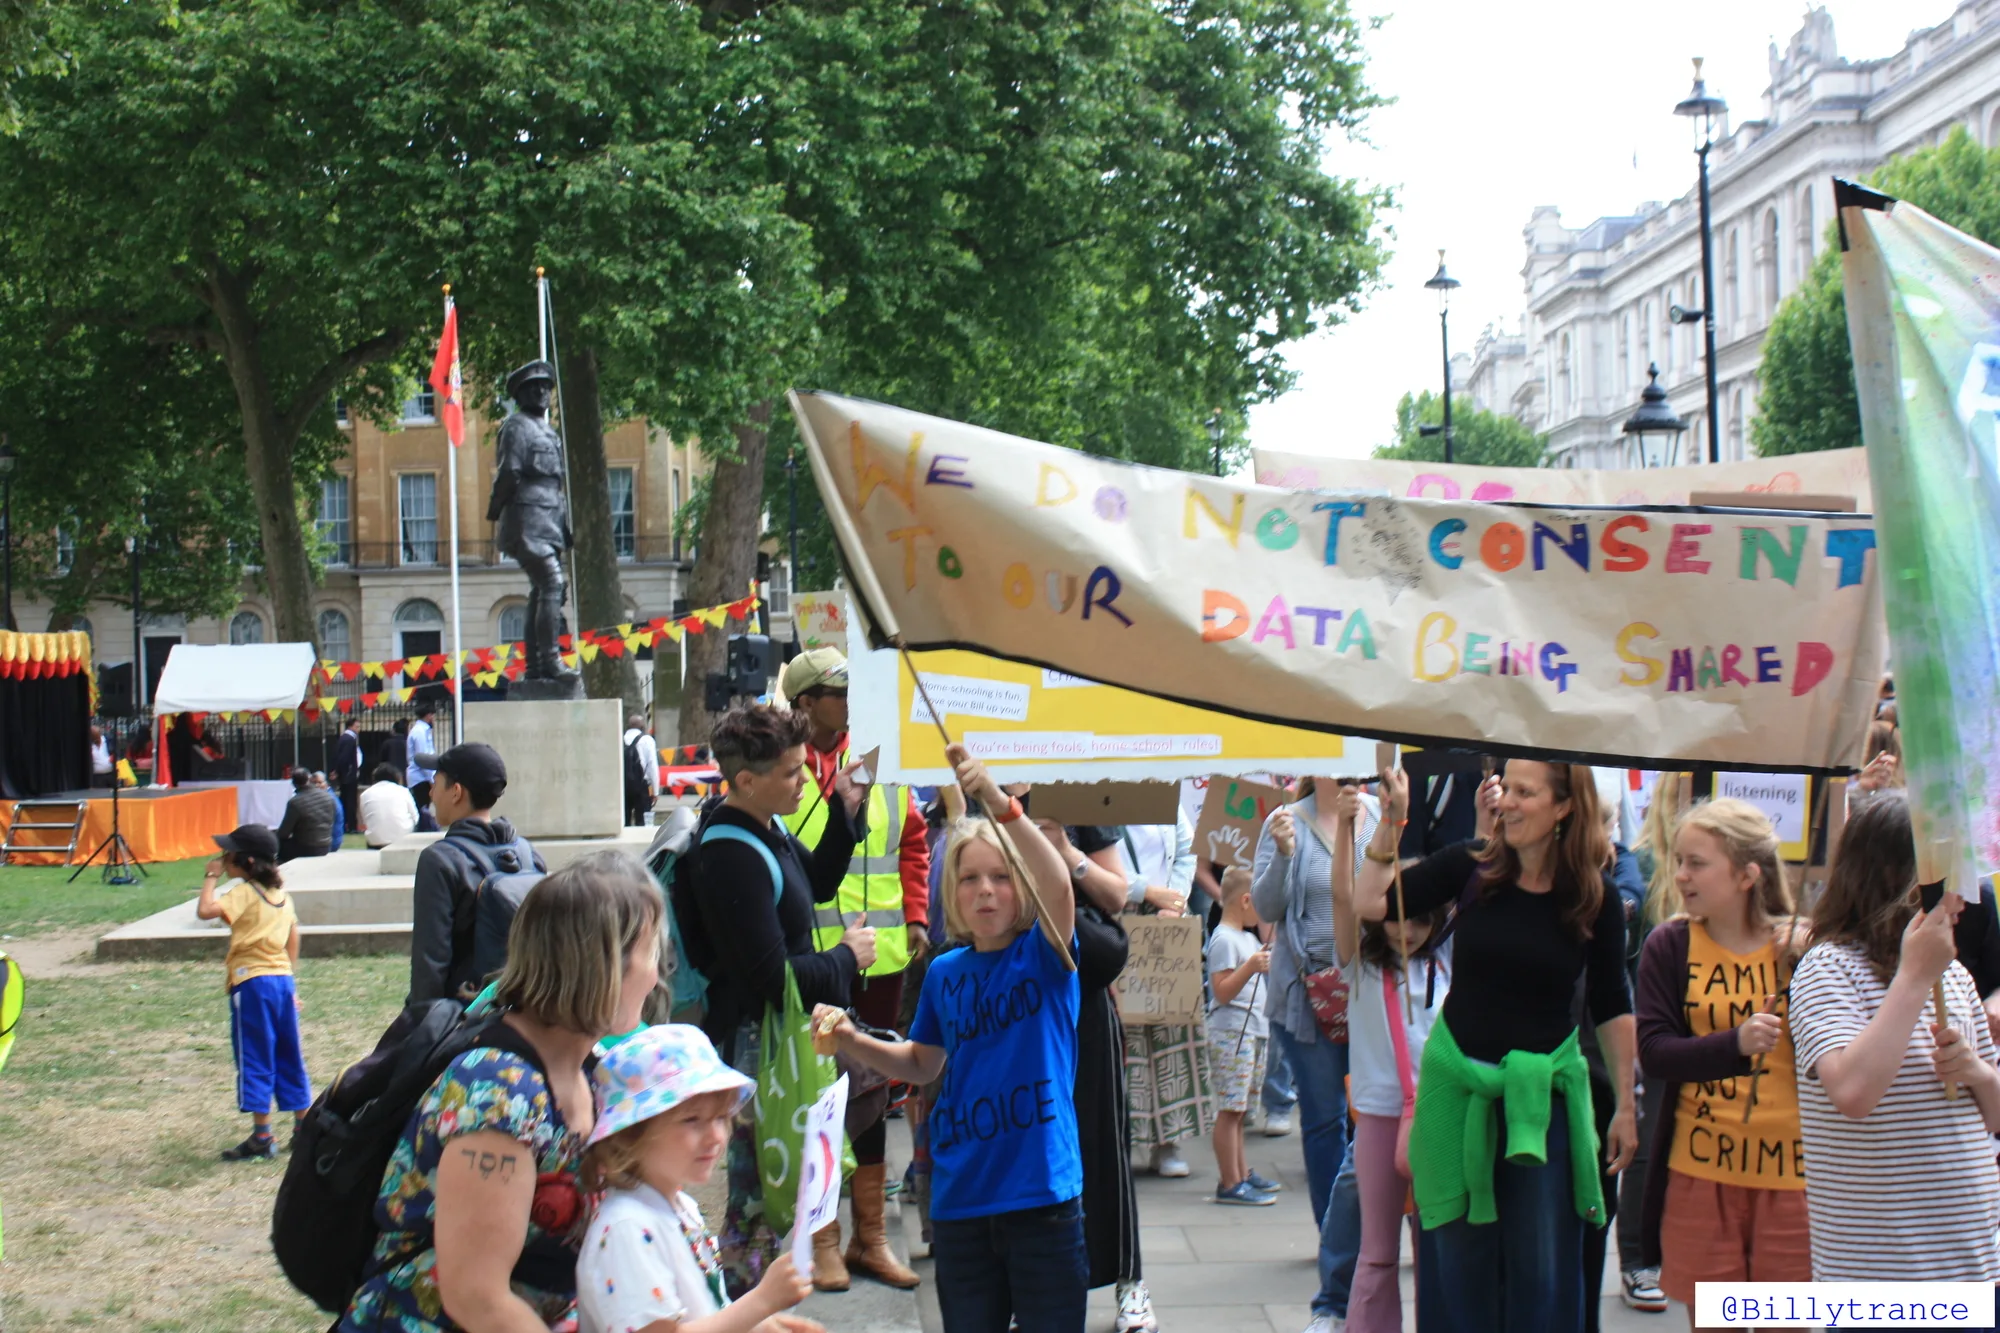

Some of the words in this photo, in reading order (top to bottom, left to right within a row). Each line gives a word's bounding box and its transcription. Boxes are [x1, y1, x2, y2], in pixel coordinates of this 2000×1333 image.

[850, 420, 974, 515] WE
[1036, 460, 1128, 524] DO
[1182, 487, 1367, 567] NOT
[1428, 514, 1876, 590] CONSENT
[887, 525, 963, 592] TO
[1003, 562, 1135, 628] OUR
[1202, 589, 1378, 661] DATA
[1412, 611, 1578, 693] BEING
[1615, 621, 1834, 697] SHARED
[995, 689, 1003, 698] is
[1004, 690, 1023, 702] fun,
[947, 699, 967, 708] your
[970, 701, 984, 710] Bill
[986, 704, 997, 713] up
[1000, 706, 1021, 715] your
[971, 741, 1011, 753] You're
[1013, 741, 1048, 755] being
[1051, 742, 1086, 755] fools,
[1724, 781, 1797, 805] listening
[1128, 927, 1191, 947] CRAPPY
[1116, 976, 1178, 995] CRAPPY
[934, 1079, 1057, 1149] CHOICE
